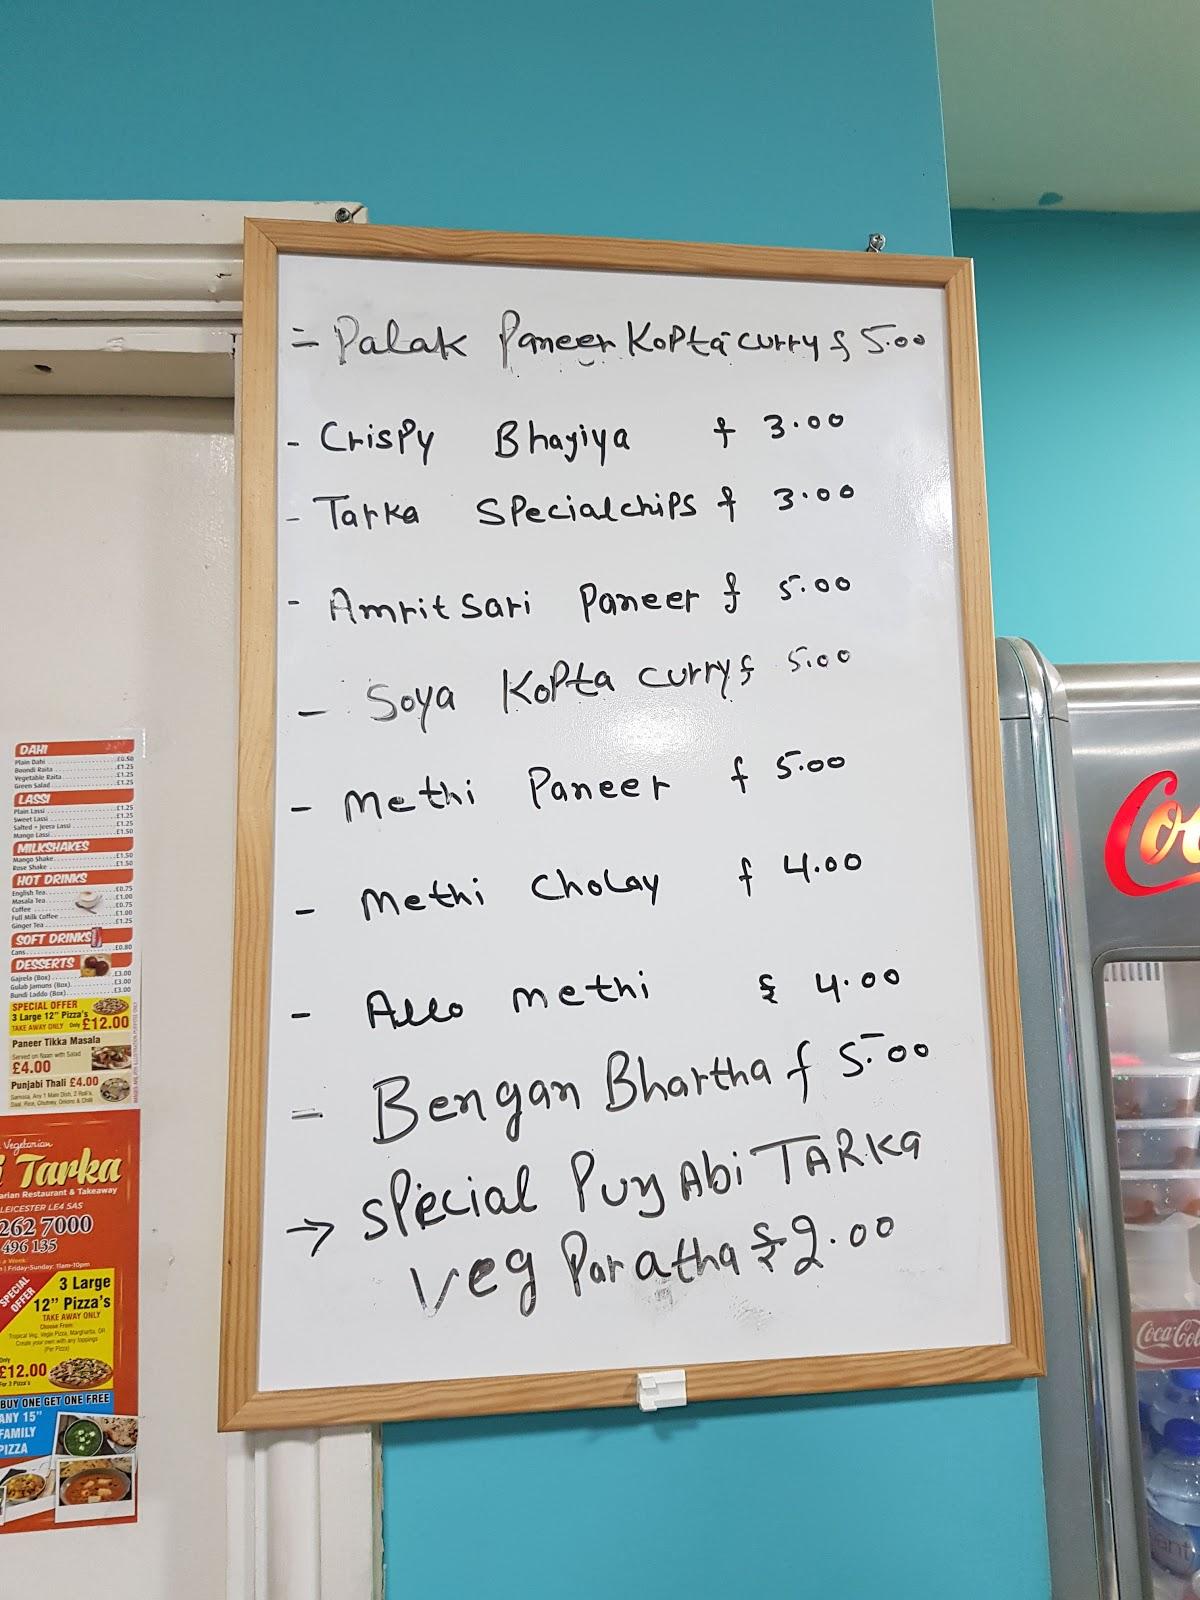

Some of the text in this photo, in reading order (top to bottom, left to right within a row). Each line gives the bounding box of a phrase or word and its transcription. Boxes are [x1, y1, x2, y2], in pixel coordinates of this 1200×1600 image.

[336, 315, 468, 366] Palak
[498, 309, 617, 369] Paneer
[860, 323, 926, 354] 5.00
[763, 413, 844, 440] 3.00
[773, 484, 855, 511] 3.00
[579, 582, 700, 624] Paneer
[779, 574, 851, 601] 5.00
[366, 685, 456, 734] Soya
[787, 645, 850, 673] 5.00
[20, 744, 48, 755] DAHI
[527, 766, 671, 810] Paneer
[776, 750, 846, 780] 5.00
[18, 794, 51, 805] LASSI
[17, 841, 90, 854] MILKSHAKES
[783, 852, 862, 884] 4.00
[17, 873, 88, 886] HOT DRINKS
[15, 932, 92, 945] SOFT DRINKS
[16, 957, 75, 971] DESSERTS
[815, 968, 900, 1004] 4.00
[12, 1000, 78, 1012] SPECIAL OFFER
[12, 1013, 17, 1021] 3
[20, 1012, 41, 1022] Large
[61, 1010, 89, 1019] Pizza's
[82, 1016, 129, 1030] £12.00
[12, 1036, 101, 1048] Paneer Tikka Masala
[12, 1060, 51, 1074] £4.00
[11, 1076, 99, 1090] Punjabi Thali £4.00
[372, 1075, 581, 1145] Bengan
[605, 1050, 772, 1113] Bhartha
[839, 1032, 929, 1078] 5.00
[4, 1138, 53, 1156] Vegetarian
[16, 1147, 122, 1188] Tarka
[22, 1188, 67, 1198] Restaurant
[77, 1187, 118, 1195] Takeaway
[0, 1204, 46, 1213] LEICESTER
[0, 1214, 94, 1238] 262 7000
[2, 1238, 57, 1254] 496 135
[791, 1214, 895, 1276] 2.00
[59, 1276, 111, 1291] 3 Large
[0, 1276, 31, 1308] SPECIAL
[10, 1287, 36, 1313] OFFER
[83, 1311, 101, 1319] ONLY
[0, 1362, 47, 1379] £12.00
[0, 1393, 110, 1409] BUY ONE GET ONE FREE
[0, 1412, 20, 1423] ANY
[0, 1426, 36, 1439] FAMILY
[0, 1442, 28, 1455] PIZZA
